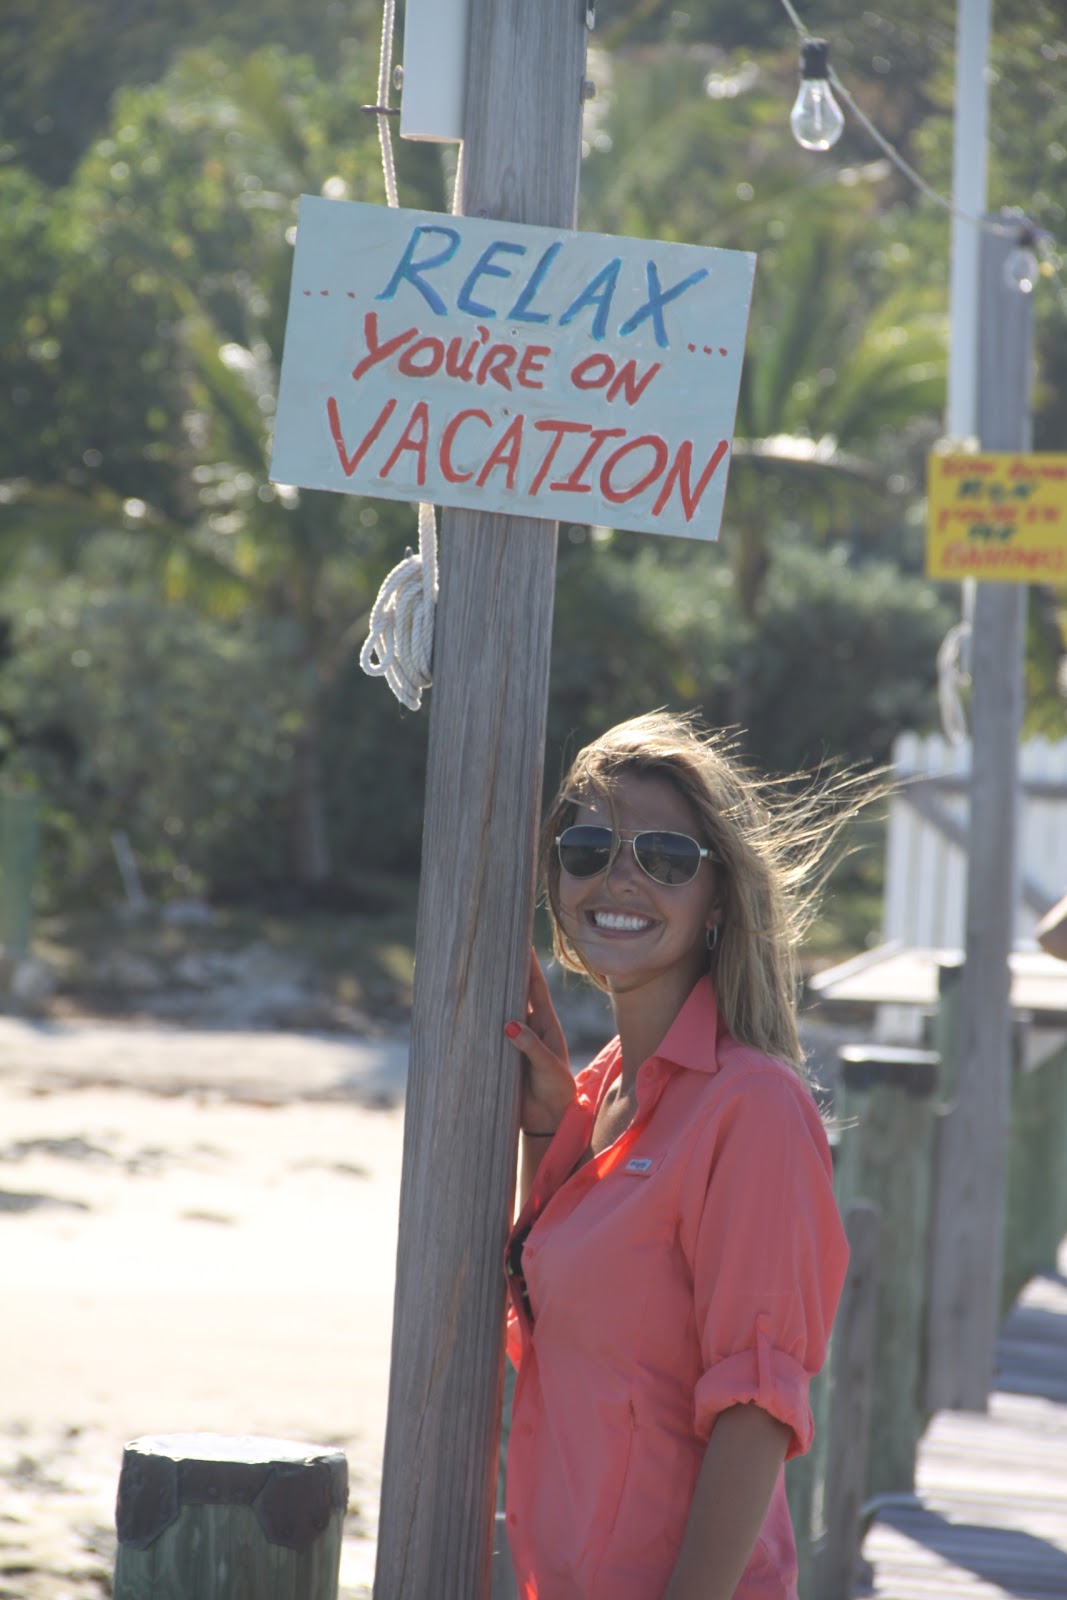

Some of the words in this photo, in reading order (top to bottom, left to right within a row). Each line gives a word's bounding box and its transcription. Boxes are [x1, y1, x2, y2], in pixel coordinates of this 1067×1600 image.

[352, 312, 552, 391] YOU'RE
[570, 353, 661, 405] ON
[327, 397, 728, 522] VACATION
